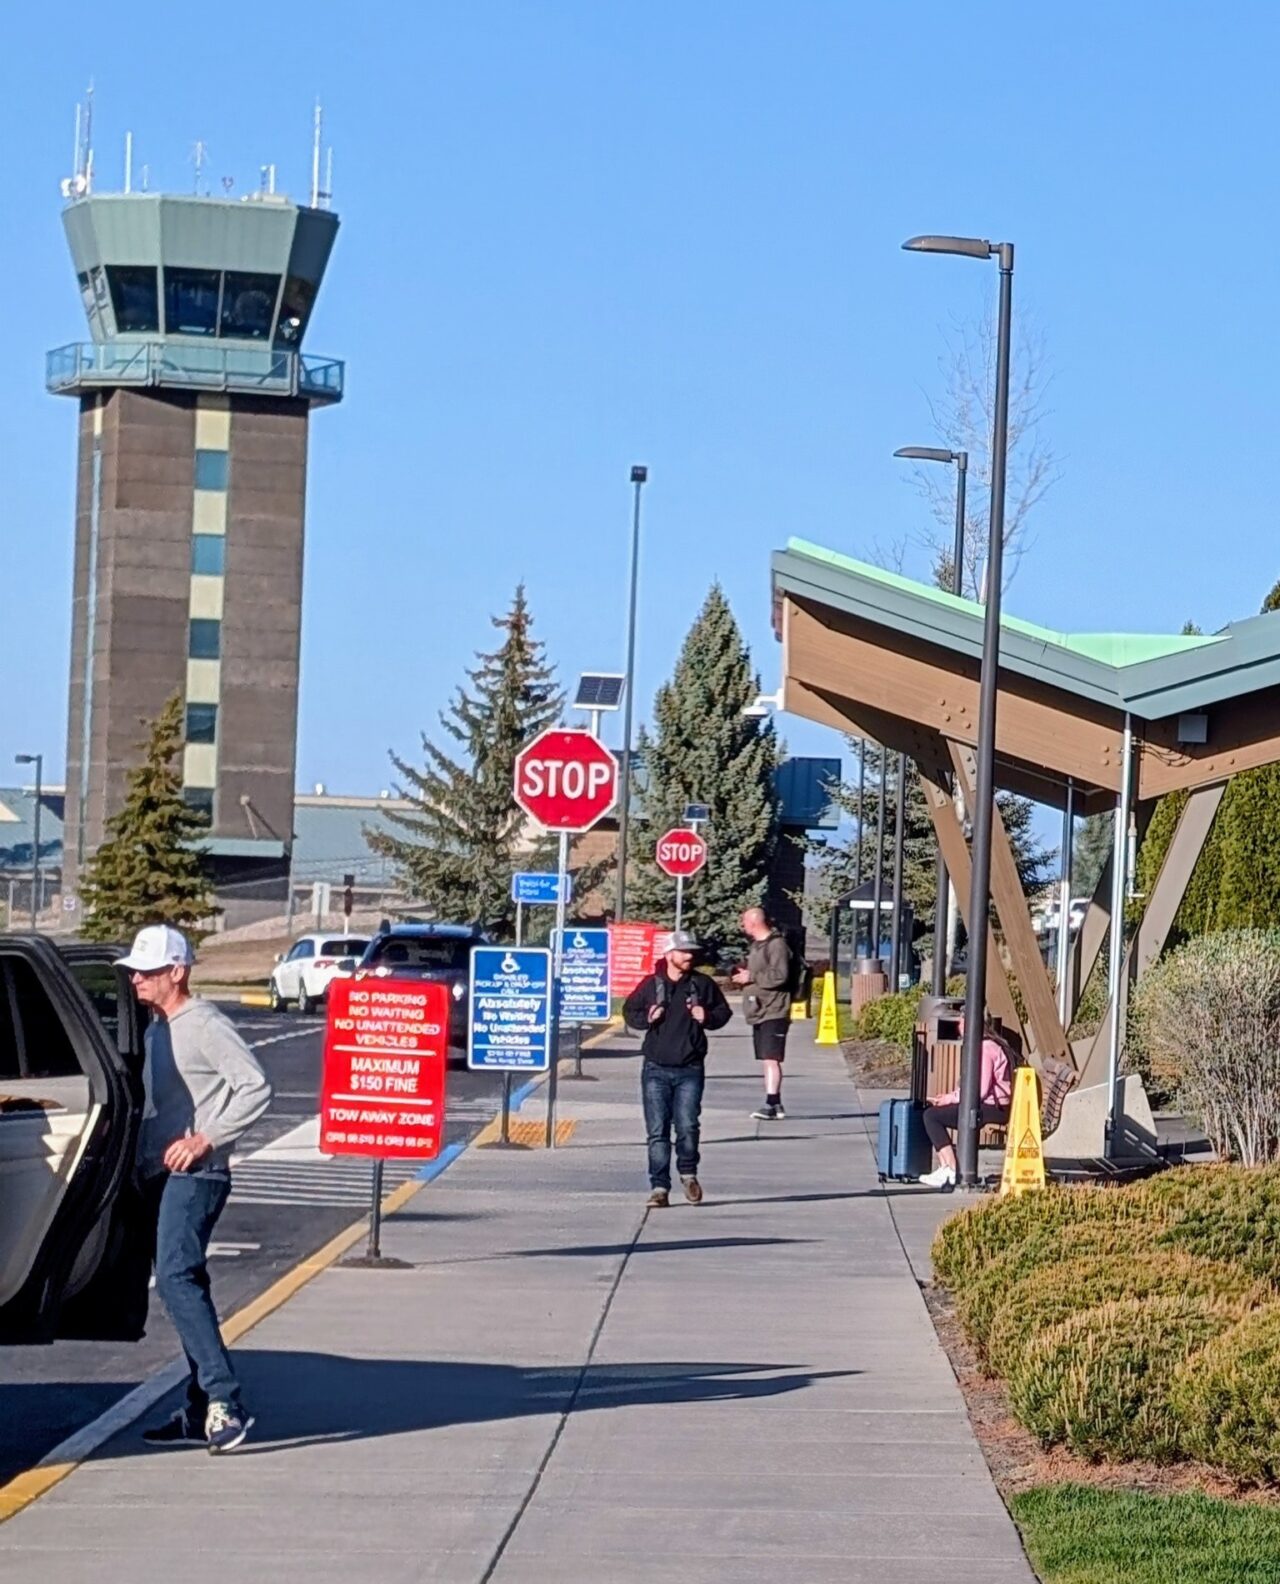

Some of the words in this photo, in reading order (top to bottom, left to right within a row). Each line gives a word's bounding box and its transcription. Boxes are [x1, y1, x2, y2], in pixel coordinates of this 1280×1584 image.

[522, 758, 611, 800] STOP
[659, 844, 704, 862] STOP
[349, 992, 370, 1002] NO
[371, 993, 427, 1006] PARKING
[478, 998, 542, 1012] Absolutely
[348, 1006, 370, 1016] NO
[371, 1007, 425, 1020] WAITING
[482, 1012, 498, 1022] No
[499, 1012, 536, 1024] Waiting
[334, 1018, 354, 1030] NO
[356, 1020, 440, 1035] UNATTENDED
[474, 1022, 488, 1033] No
[490, 1023, 546, 1034] Unattended
[355, 1034, 418, 1048] VEHICLES
[488, 1034, 530, 1044] Vehicles
[351, 1057, 420, 1075] MAXIMUM
[350, 1074, 382, 1090] $150
[386, 1076, 418, 1093] FINE
[328, 1108, 360, 1122] TOW
[360, 1110, 398, 1124] AWAY
[398, 1112, 434, 1126] ZONE
